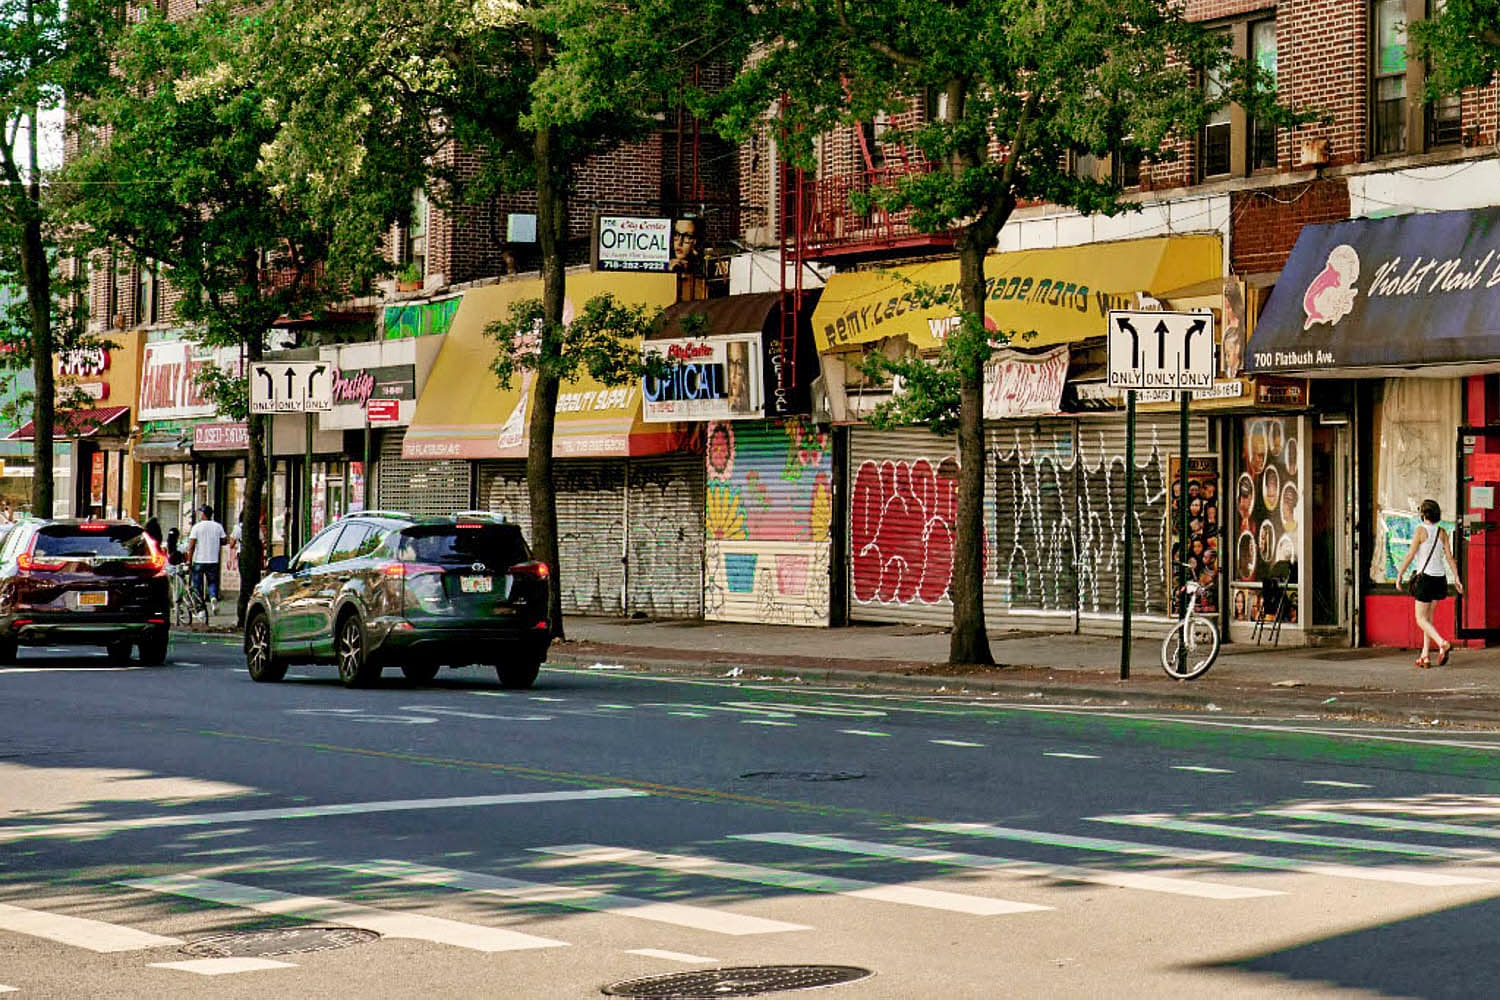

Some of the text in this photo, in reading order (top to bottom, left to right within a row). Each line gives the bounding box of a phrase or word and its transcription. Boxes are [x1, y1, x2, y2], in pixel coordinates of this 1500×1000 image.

[602, 229, 667, 250] OPTICAL
[1368, 254, 1437, 298] Violet
[1429, 248, 1496, 294] Nail
[1254, 349, 1336, 367] 700 Flatbush Ave.
[331, 367, 375, 408] Prestige
[1112, 371, 1210, 385] ONLY ONLY ONLY
[253, 400, 329, 410] ONLY ONLY ONLY
[594, 386, 637, 411] SUPPLY
